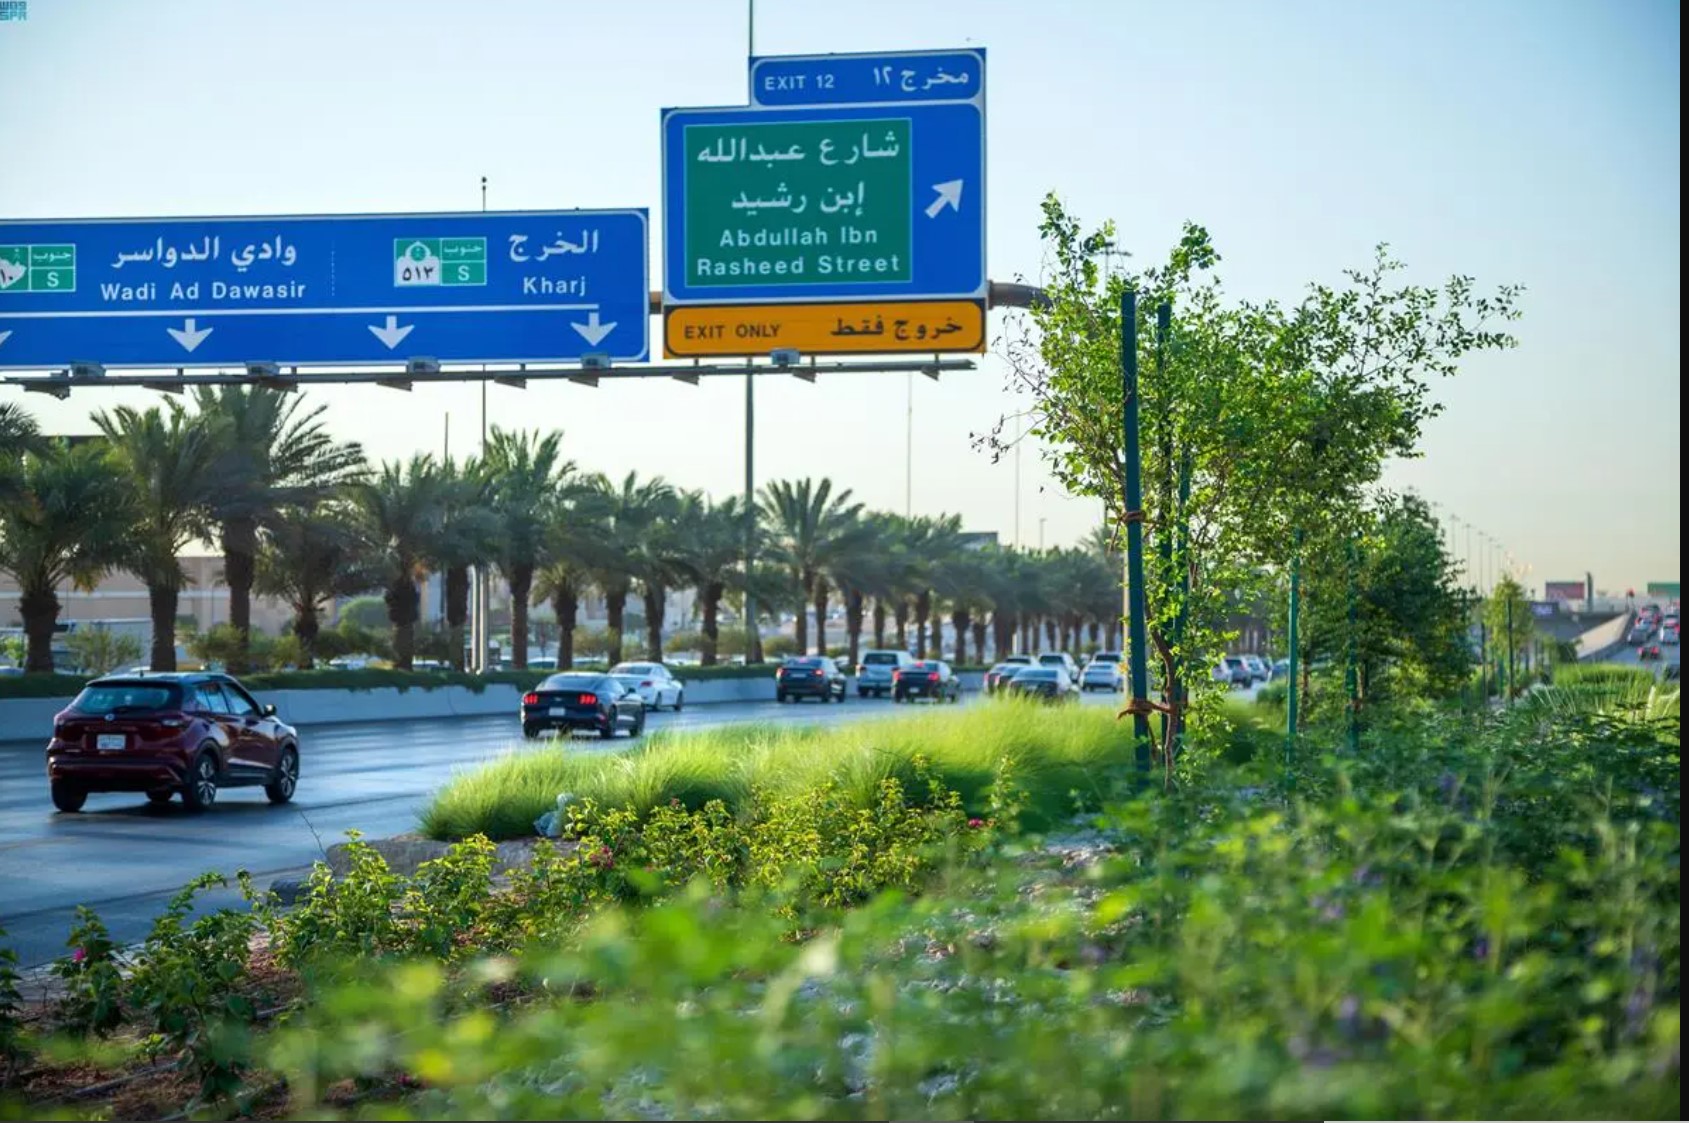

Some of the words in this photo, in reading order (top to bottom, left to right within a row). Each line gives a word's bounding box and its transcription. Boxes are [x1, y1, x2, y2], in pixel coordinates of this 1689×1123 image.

[764, 75, 806, 91] EXIT
[816, 74, 835, 89] 12
[873, 66, 893, 87] ١٢
[900, 66, 970, 91] مخرج
[697, 137, 806, 168] عبدالله
[818, 130, 900, 166] شارع
[731, 182, 807, 216] رشيد
[819, 181, 865, 216] إبن
[508, 229, 599, 262] الخرج
[719, 228, 829, 248] Abdullah
[840, 226, 878, 245] Ibn
[32, 250, 72, 262] جنوب
[111, 235, 219, 269] الدواسر
[231, 234, 297, 272] وادي
[443, 243, 483, 256] جنوب
[458, 264, 470, 281] S
[697, 257, 804, 276] Rasheed
[817, 254, 901, 274] Street
[47, 272, 59, 288] S
[100, 282, 156, 301] Wadi
[170, 281, 200, 300] Ad
[212, 280, 306, 299] Dawasir
[522, 276, 587, 297] Kharj
[684, 324, 725, 340] EXIT
[735, 323, 782, 338] ONLY
[830, 314, 885, 337] فقط
[893, 316, 963, 341] خروج
